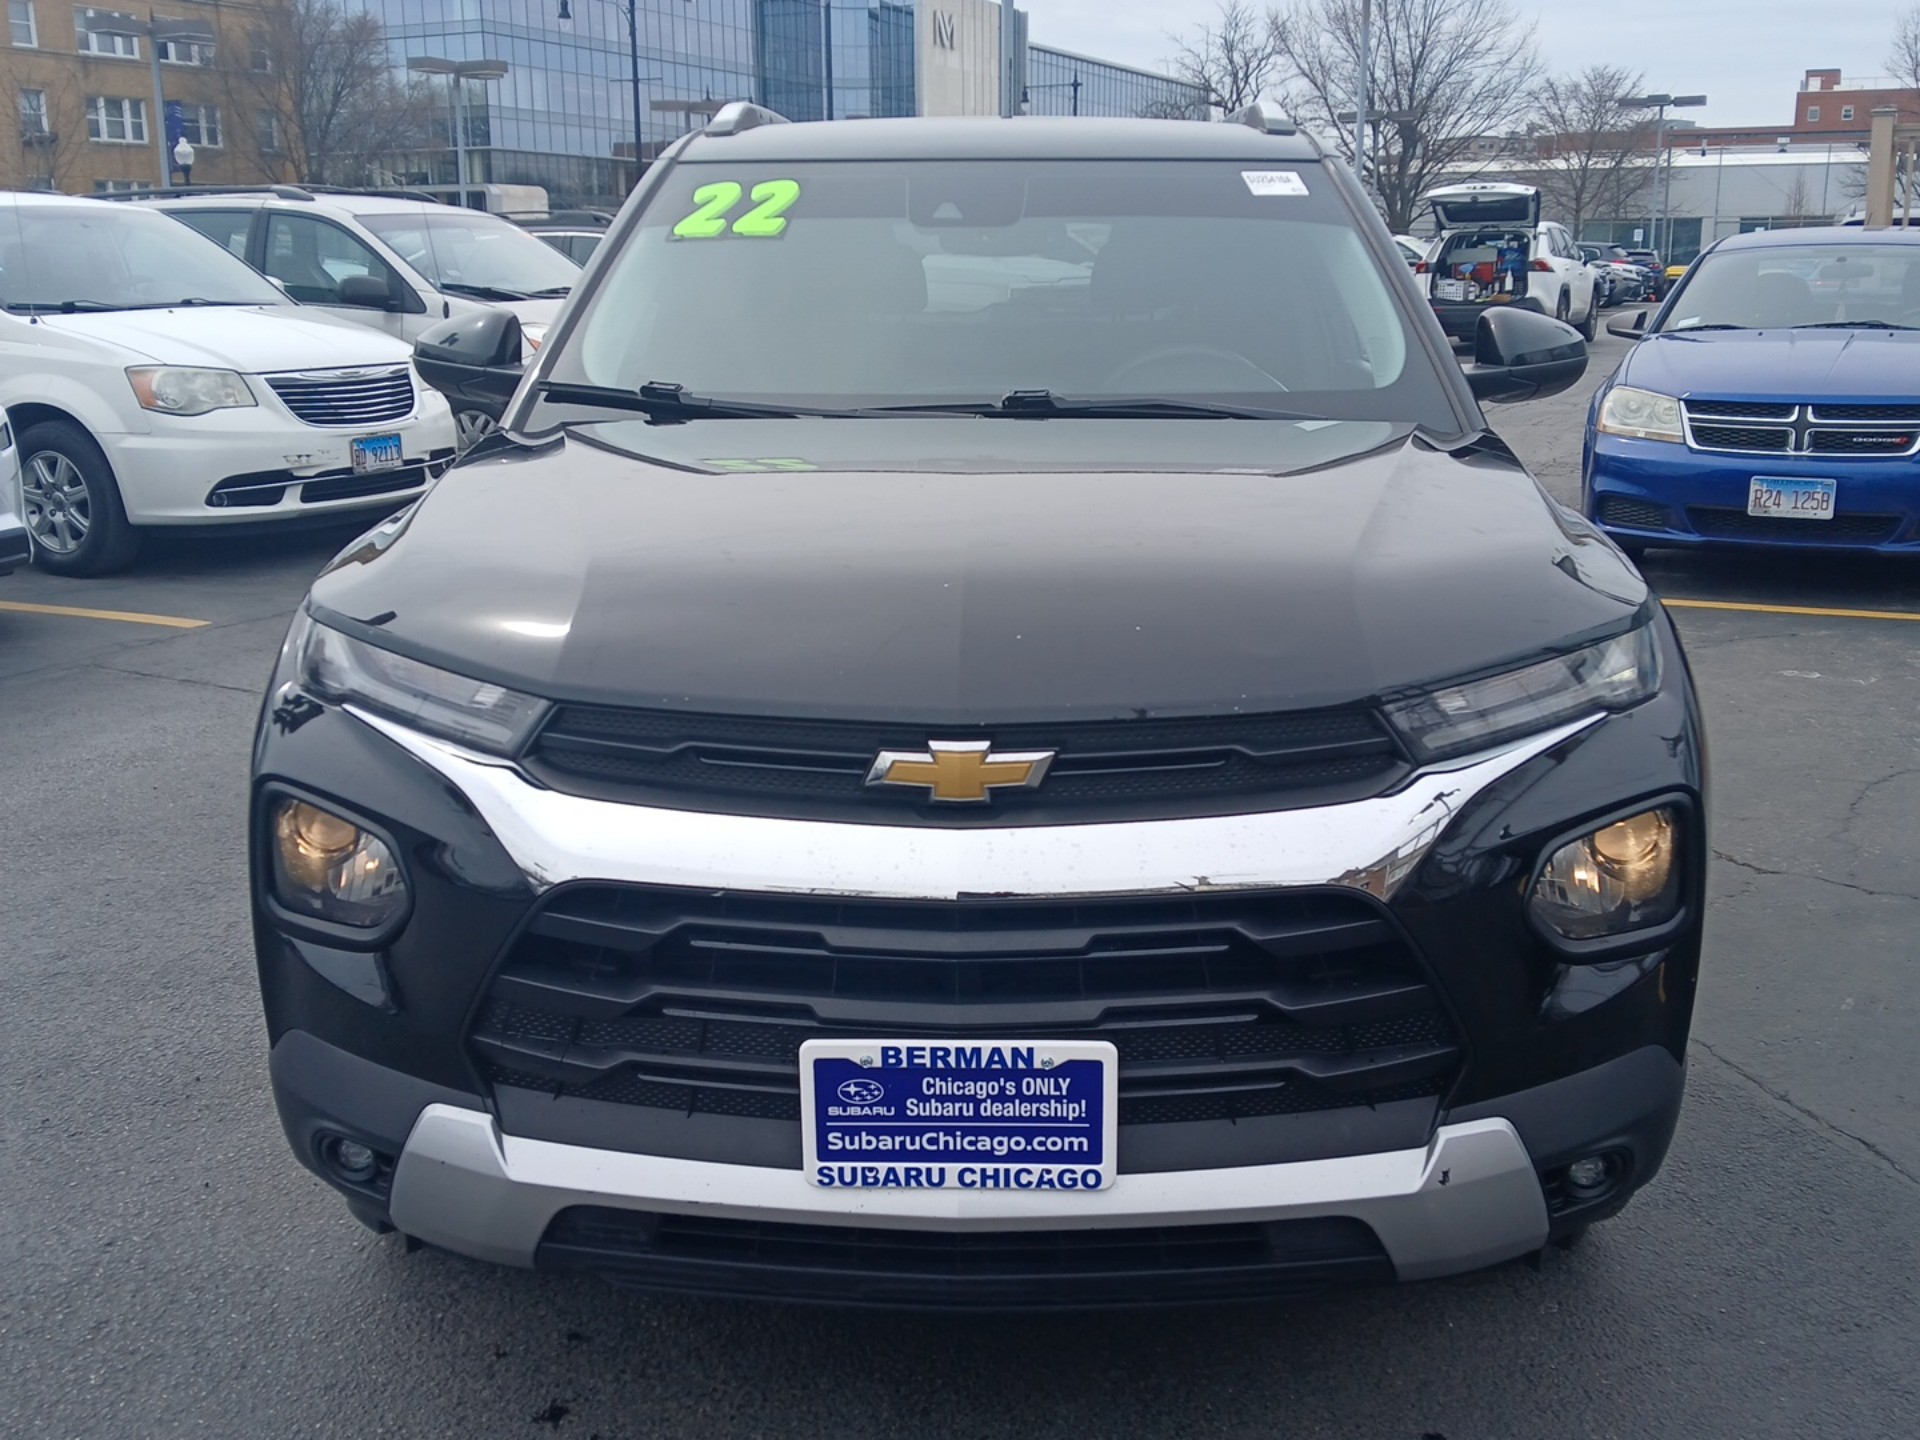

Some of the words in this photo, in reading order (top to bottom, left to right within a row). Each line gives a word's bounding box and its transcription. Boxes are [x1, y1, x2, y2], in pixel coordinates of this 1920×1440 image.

[672, 179, 800, 238] 22
[372, 443, 401, 463] 92113
[1754, 488, 1782, 508] R24
[1791, 490, 1830, 511] 1258
[880, 1046, 1035, 1069] BERMAN
[922, 1077, 1016, 1099] Chicago's
[1022, 1078, 1071, 1096] ONLY
[827, 1106, 895, 1116] SUBARU
[906, 1099, 975, 1117] Subaru
[980, 1099, 1087, 1121] dealership!
[827, 1131, 1089, 1156] SubaruChicago.com
[817, 1166, 946, 1188] SUBARU
[957, 1168, 1103, 1190] CHICAGO
